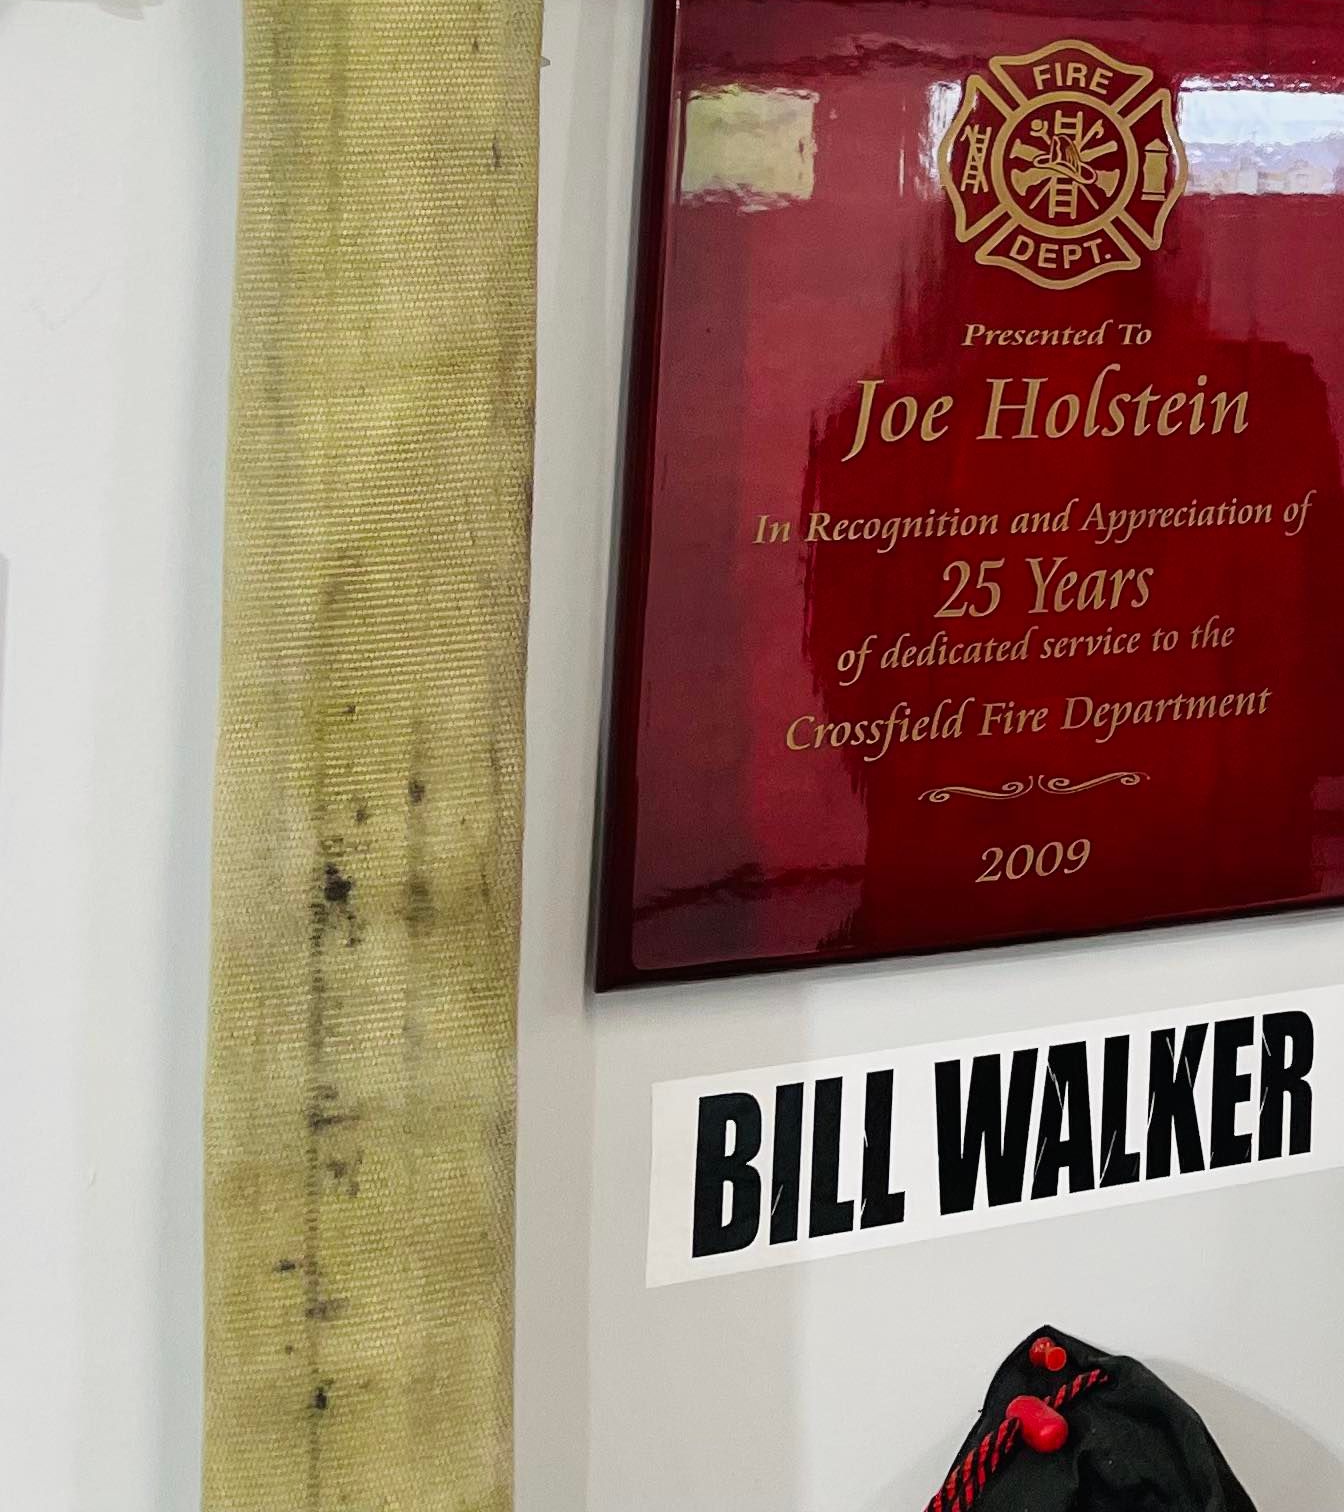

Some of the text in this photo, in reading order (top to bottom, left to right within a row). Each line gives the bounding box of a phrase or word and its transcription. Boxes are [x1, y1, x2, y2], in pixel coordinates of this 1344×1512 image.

[1033, 61, 1114, 94] FIRE
[1010, 235, 1112, 268] DEPT.
[961, 319, 1152, 347] Presented To
[841, 363, 1249, 462] Joe Holstein
[752, 489, 1317, 554] In Recognition and Appreciation of
[934, 555, 1154, 618] 25 Years
[837, 615, 1236, 687] of dedicated service to the
[786, 687, 1273, 762] Crossfield Fire Department
[975, 838, 1091, 883] 2009
[692, 1010, 1315, 1259] BILL WALKER
